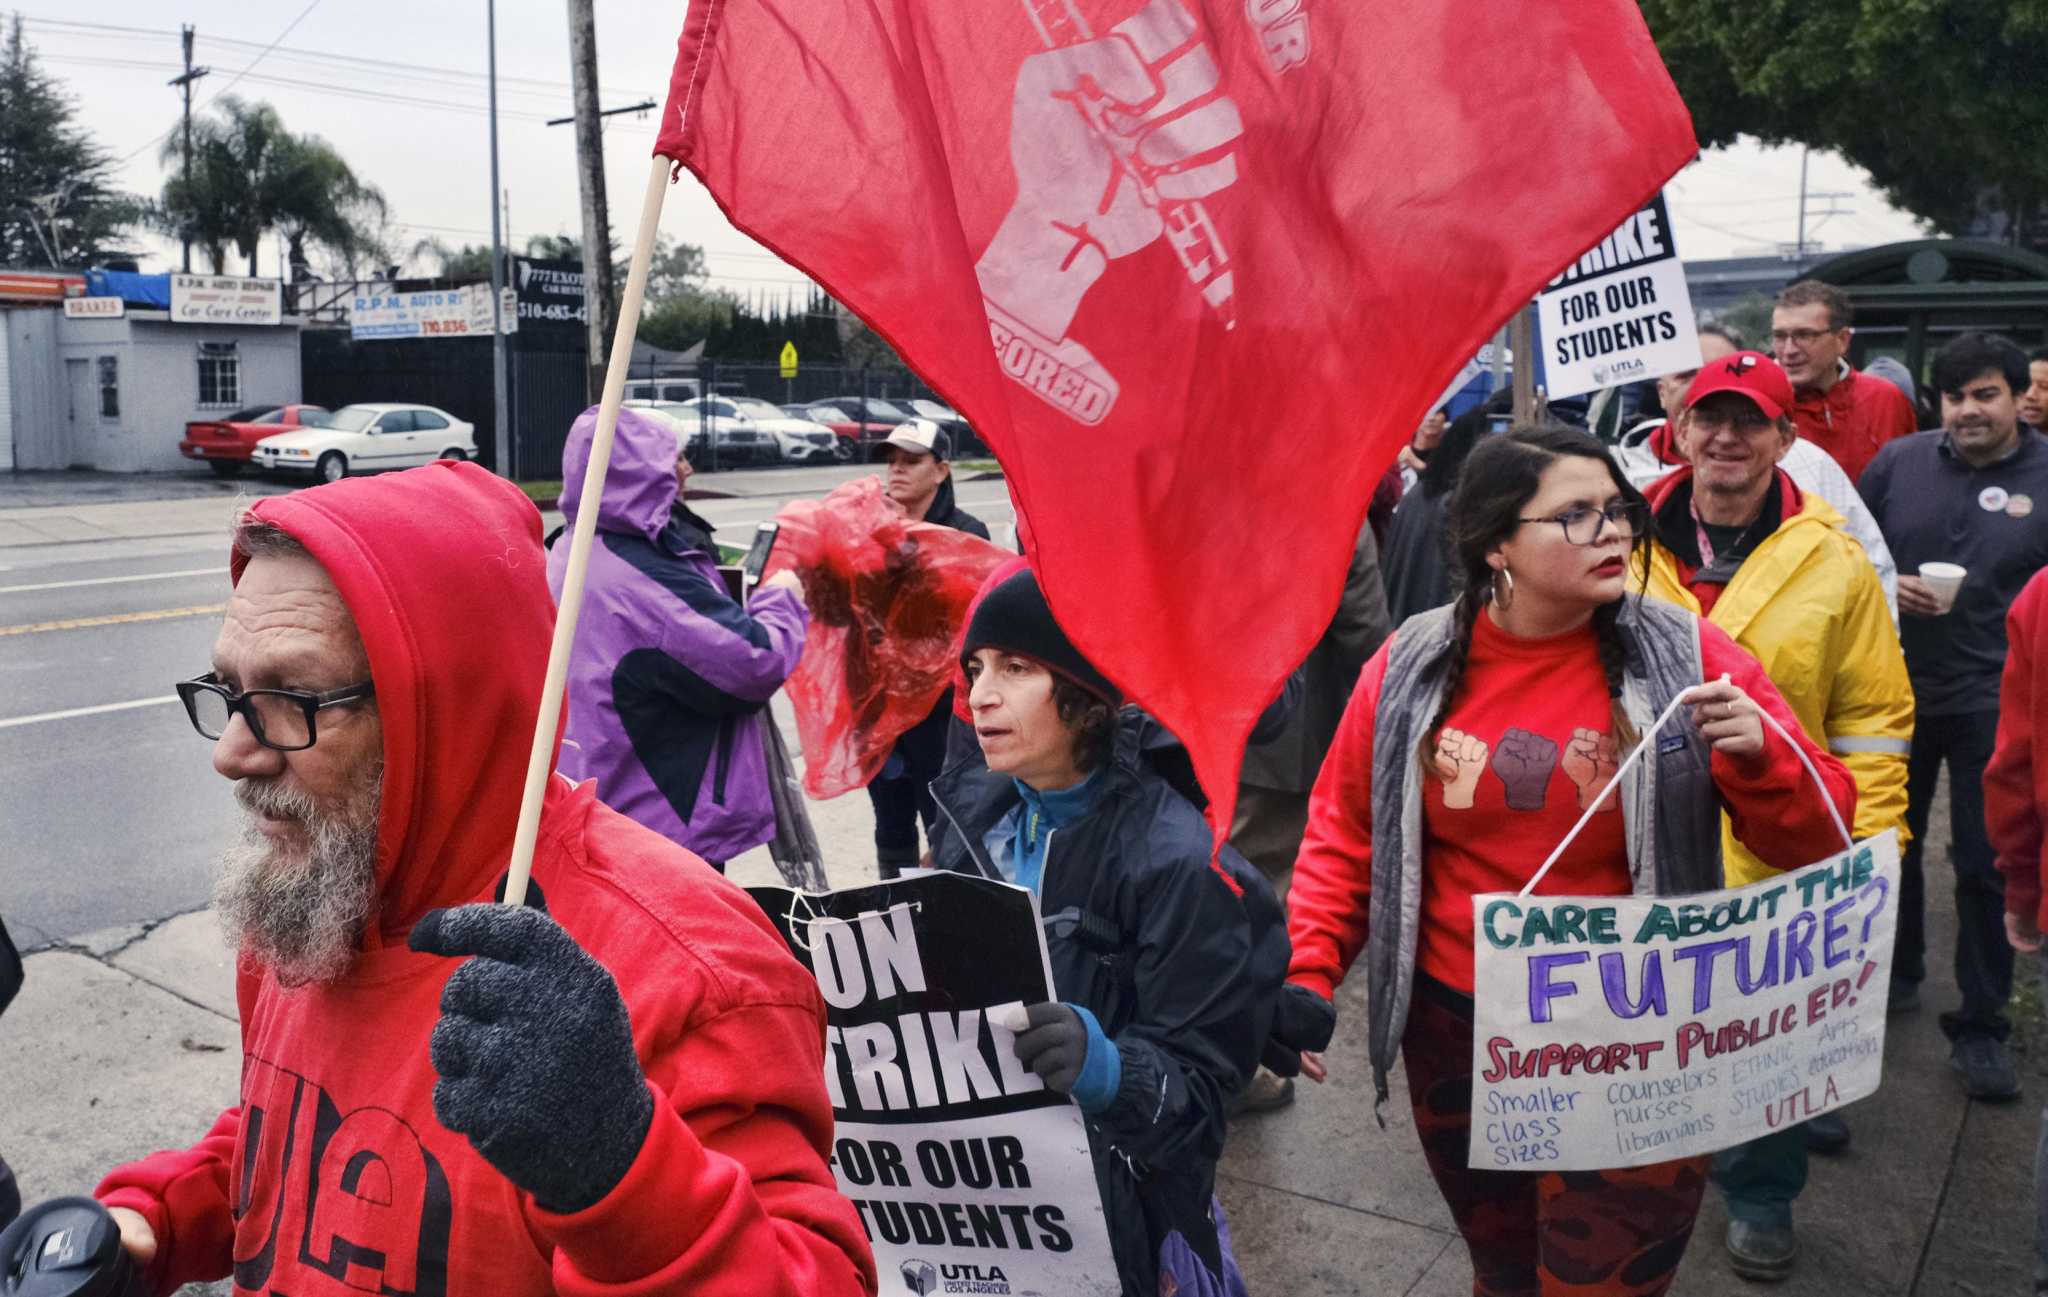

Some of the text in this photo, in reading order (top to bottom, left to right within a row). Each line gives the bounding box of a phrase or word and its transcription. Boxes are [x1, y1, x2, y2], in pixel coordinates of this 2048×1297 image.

[181, 304, 273, 318] Car Care Center
[411, 293, 444, 308] AUTO
[1560, 275, 1657, 326] FOR OUR
[1556, 310, 1677, 366] STUDENTS
[1610, 358, 1645, 373] UTLA
[1483, 846, 1874, 949] CARE ABOUT THE
[807, 902, 927, 1010] ON
[1528, 876, 1889, 1024] FUTURE?
[824, 1000, 1044, 1111] TRIKE
[1482, 1036, 1664, 1084] SUPPORT
[1676, 1003, 1798, 1070] PUBLIC
[1731, 1041, 1794, 1085] ETHNIC
[1613, 1096, 1694, 1127] nurses
[1765, 1074, 1841, 1128] UTLA
[1616, 1113, 1716, 1155] librarians
[828, 1135, 1032, 1190] OR OUR
[850, 1199, 1073, 1253] TUDENTS
[940, 1264, 1008, 1282] UTLA
